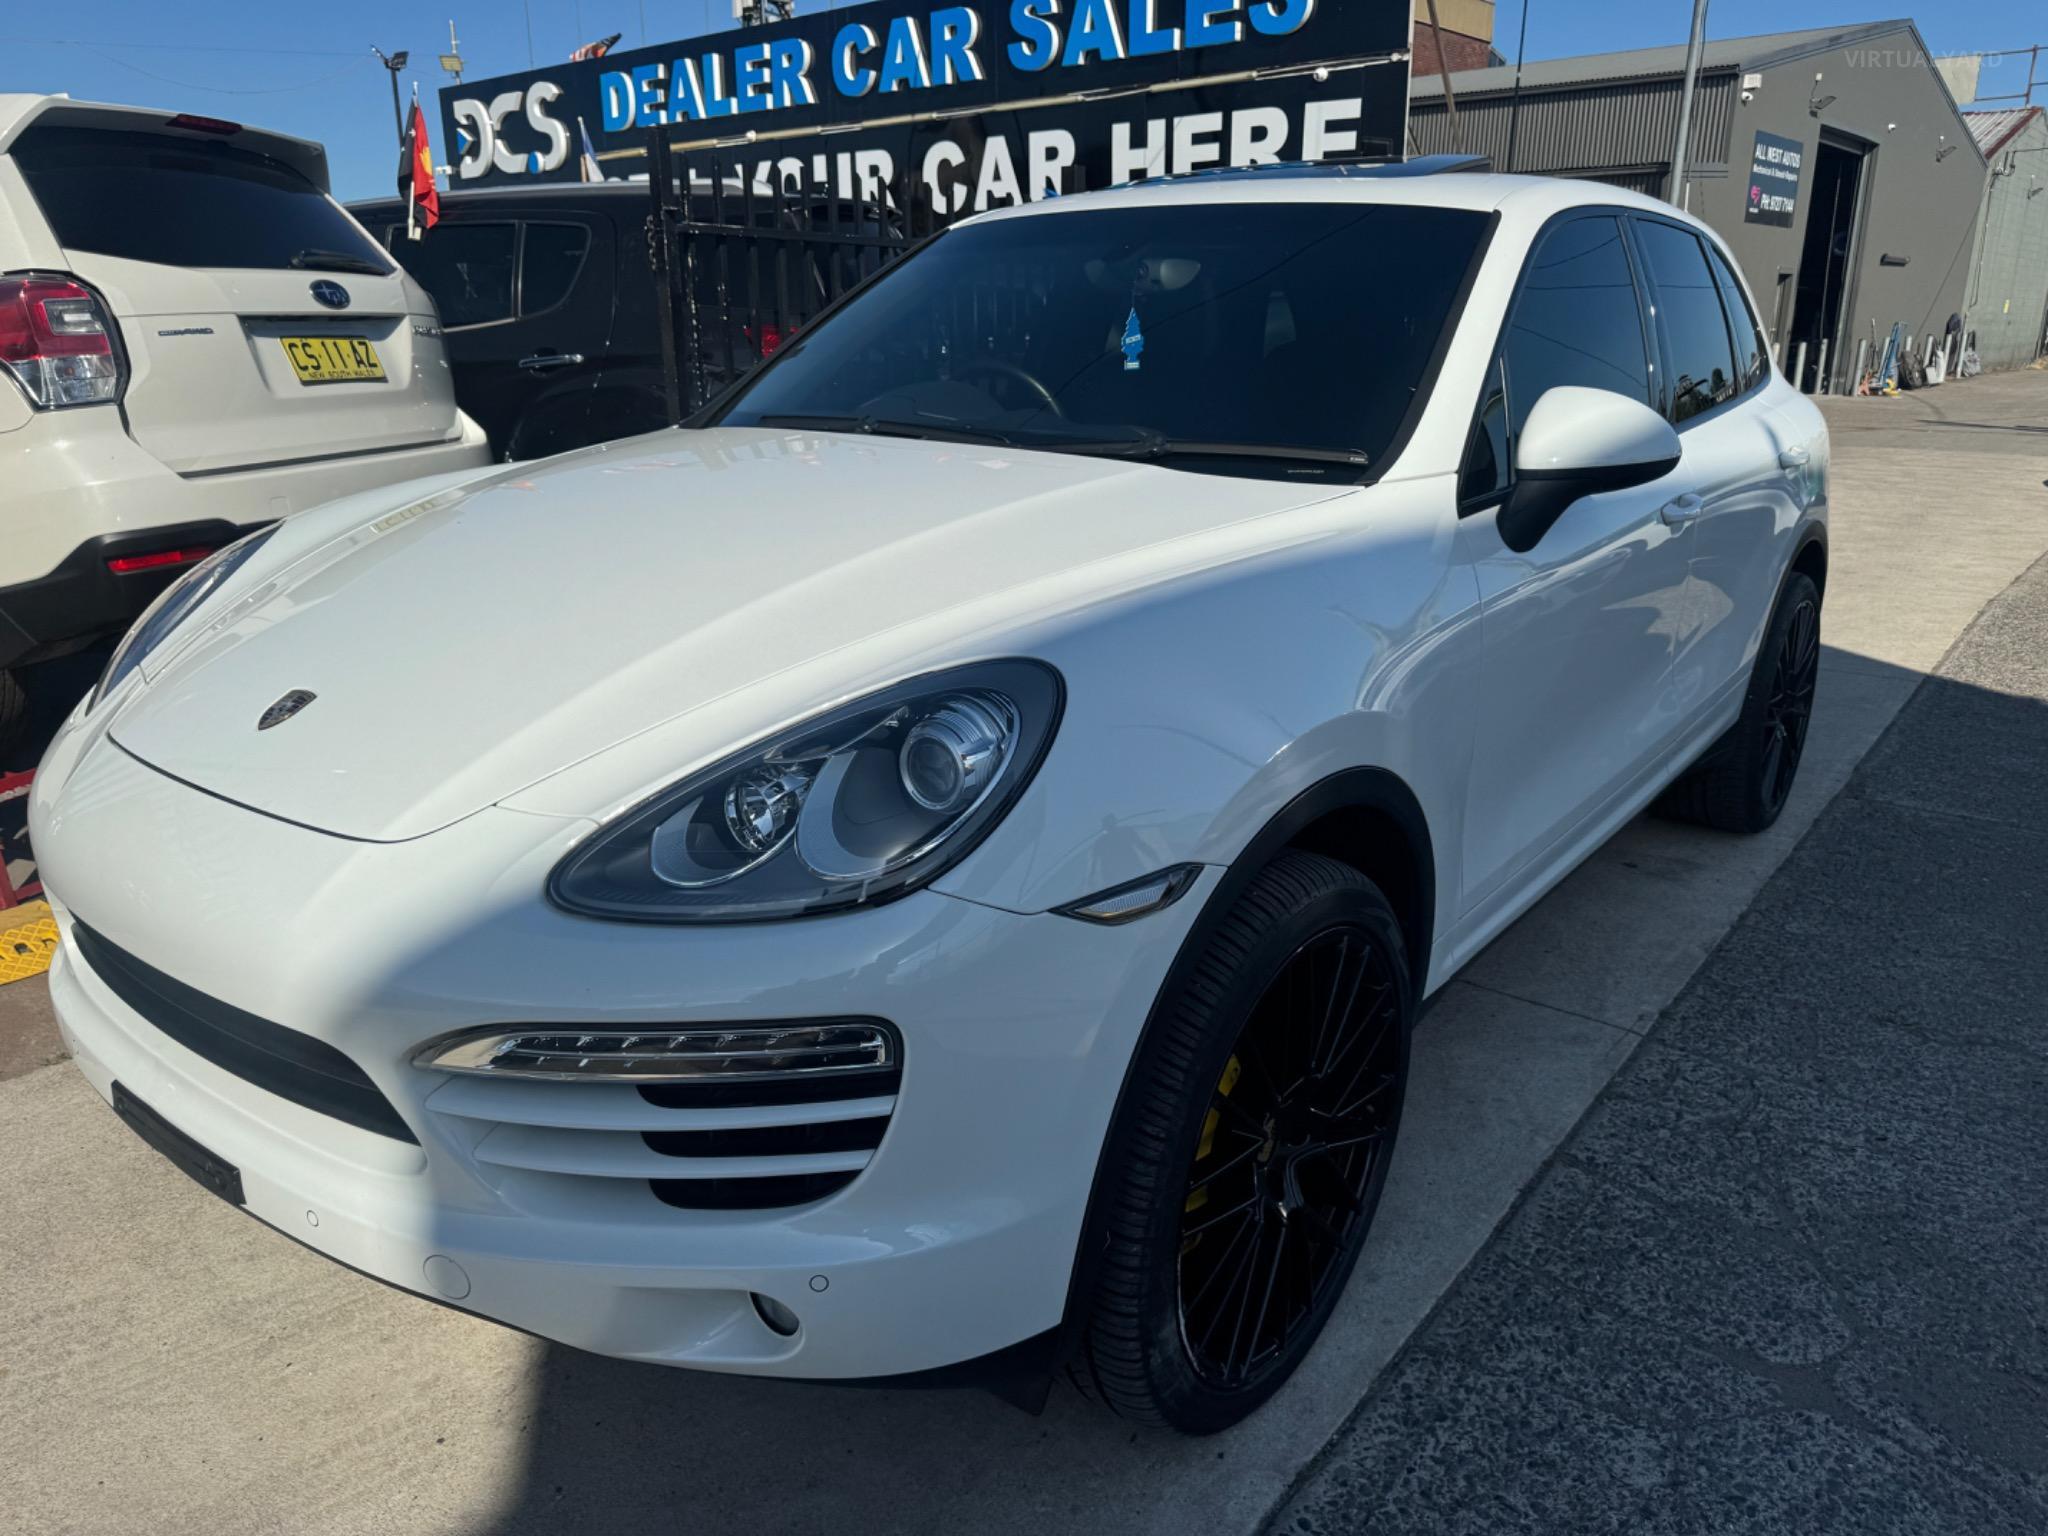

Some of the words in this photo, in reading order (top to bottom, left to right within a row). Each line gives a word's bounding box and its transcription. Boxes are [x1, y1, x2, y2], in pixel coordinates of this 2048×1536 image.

[600, 37, 817, 133] DEALER
[831, 5, 985, 98] CAR
[452, 81, 572, 180] DCS
[922, 129, 1076, 214] CAR
[1110, 98, 1363, 186] HERE
